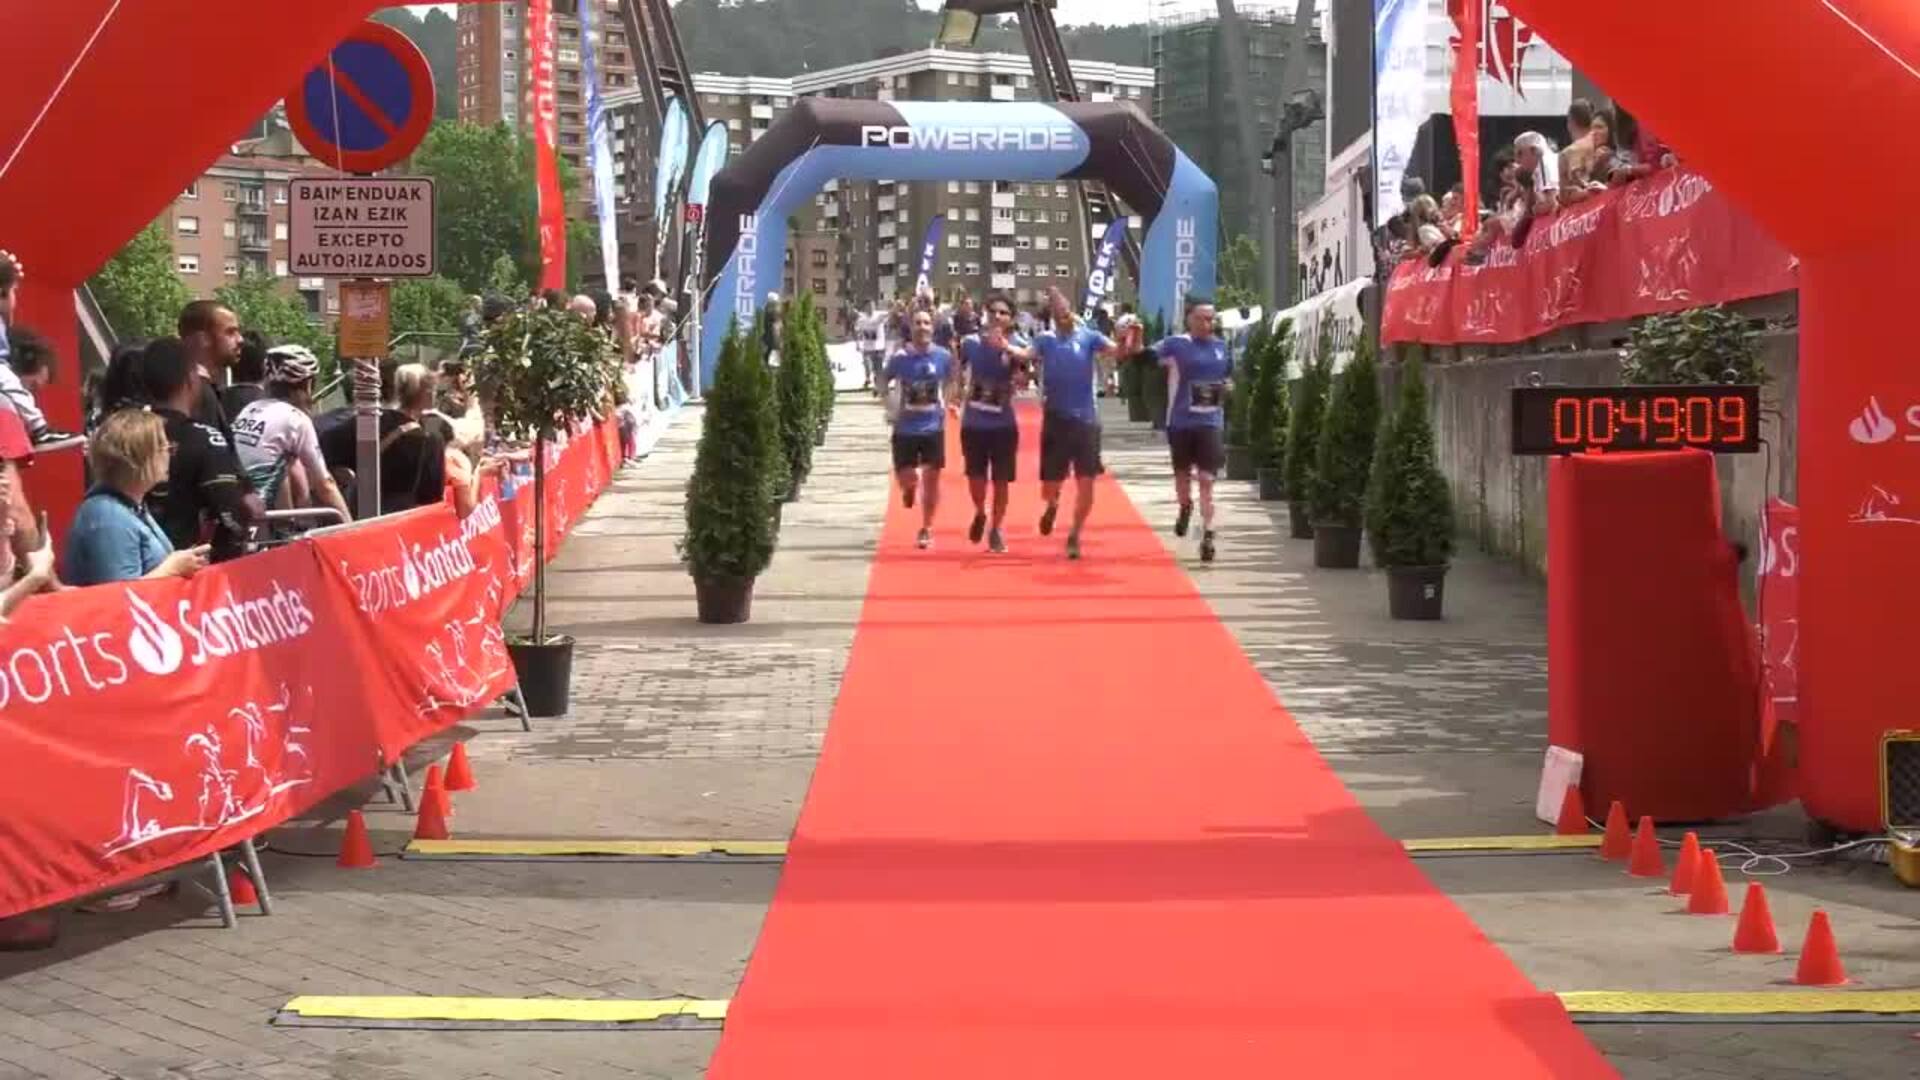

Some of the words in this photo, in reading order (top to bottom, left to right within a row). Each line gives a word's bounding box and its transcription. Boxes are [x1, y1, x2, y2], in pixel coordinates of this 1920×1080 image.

[861, 125, 1074, 151] POWERADE
[300, 186, 422, 201] BAIMENDUAK
[314, 206, 358, 221] IZAN
[368, 206, 407, 221] EZIK
[318, 233, 404, 247] EXCEPTO
[297, 253, 427, 268] AUTORIZADOS
[1175, 216, 1196, 308] RADE
[735, 213, 759, 338] WERADE
[233, 418, 267, 435] ORA
[1553, 396, 1746, 444] 00:49:09
[0, 625, 127, 708] orts
[178, 579, 314, 665] Santande
